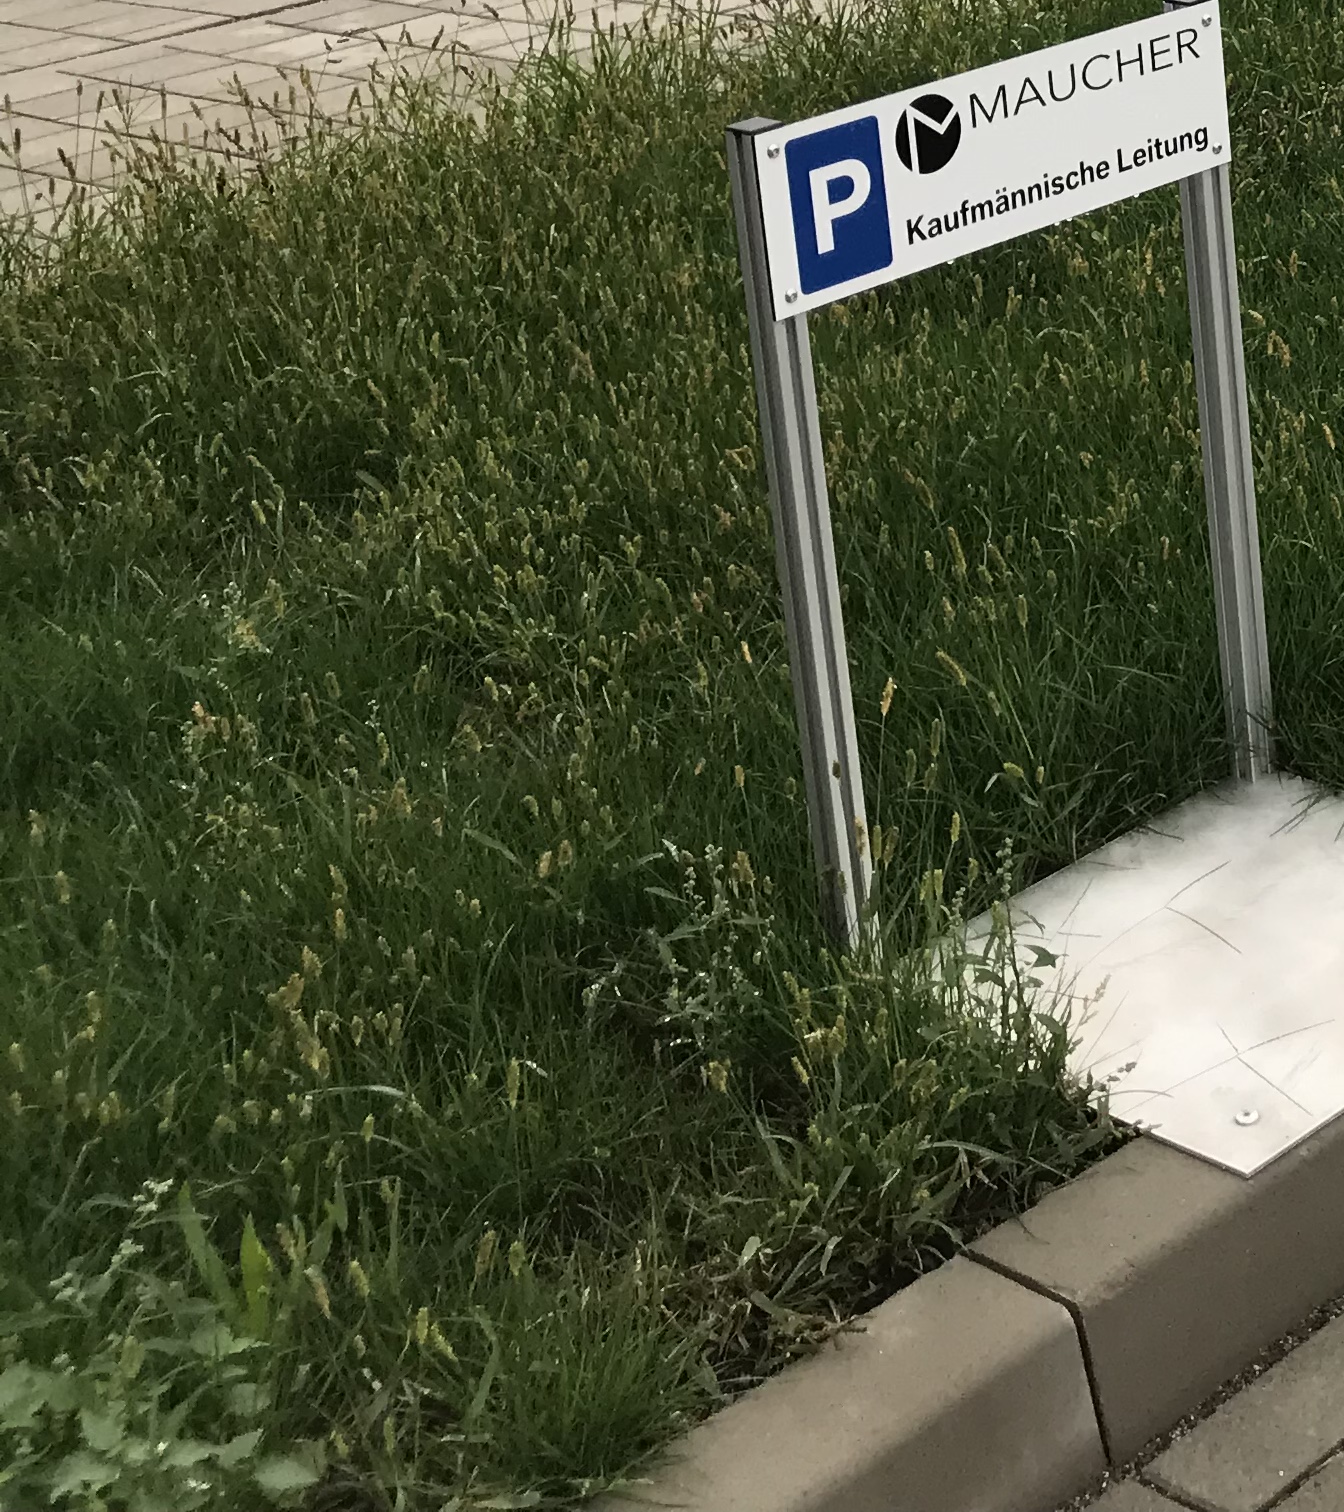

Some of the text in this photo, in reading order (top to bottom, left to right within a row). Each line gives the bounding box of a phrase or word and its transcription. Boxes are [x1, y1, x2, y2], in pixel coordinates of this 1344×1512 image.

[969, 28, 1200, 128] MAUCHER
[907, 125, 1210, 245] Kaufmännische Leitung
